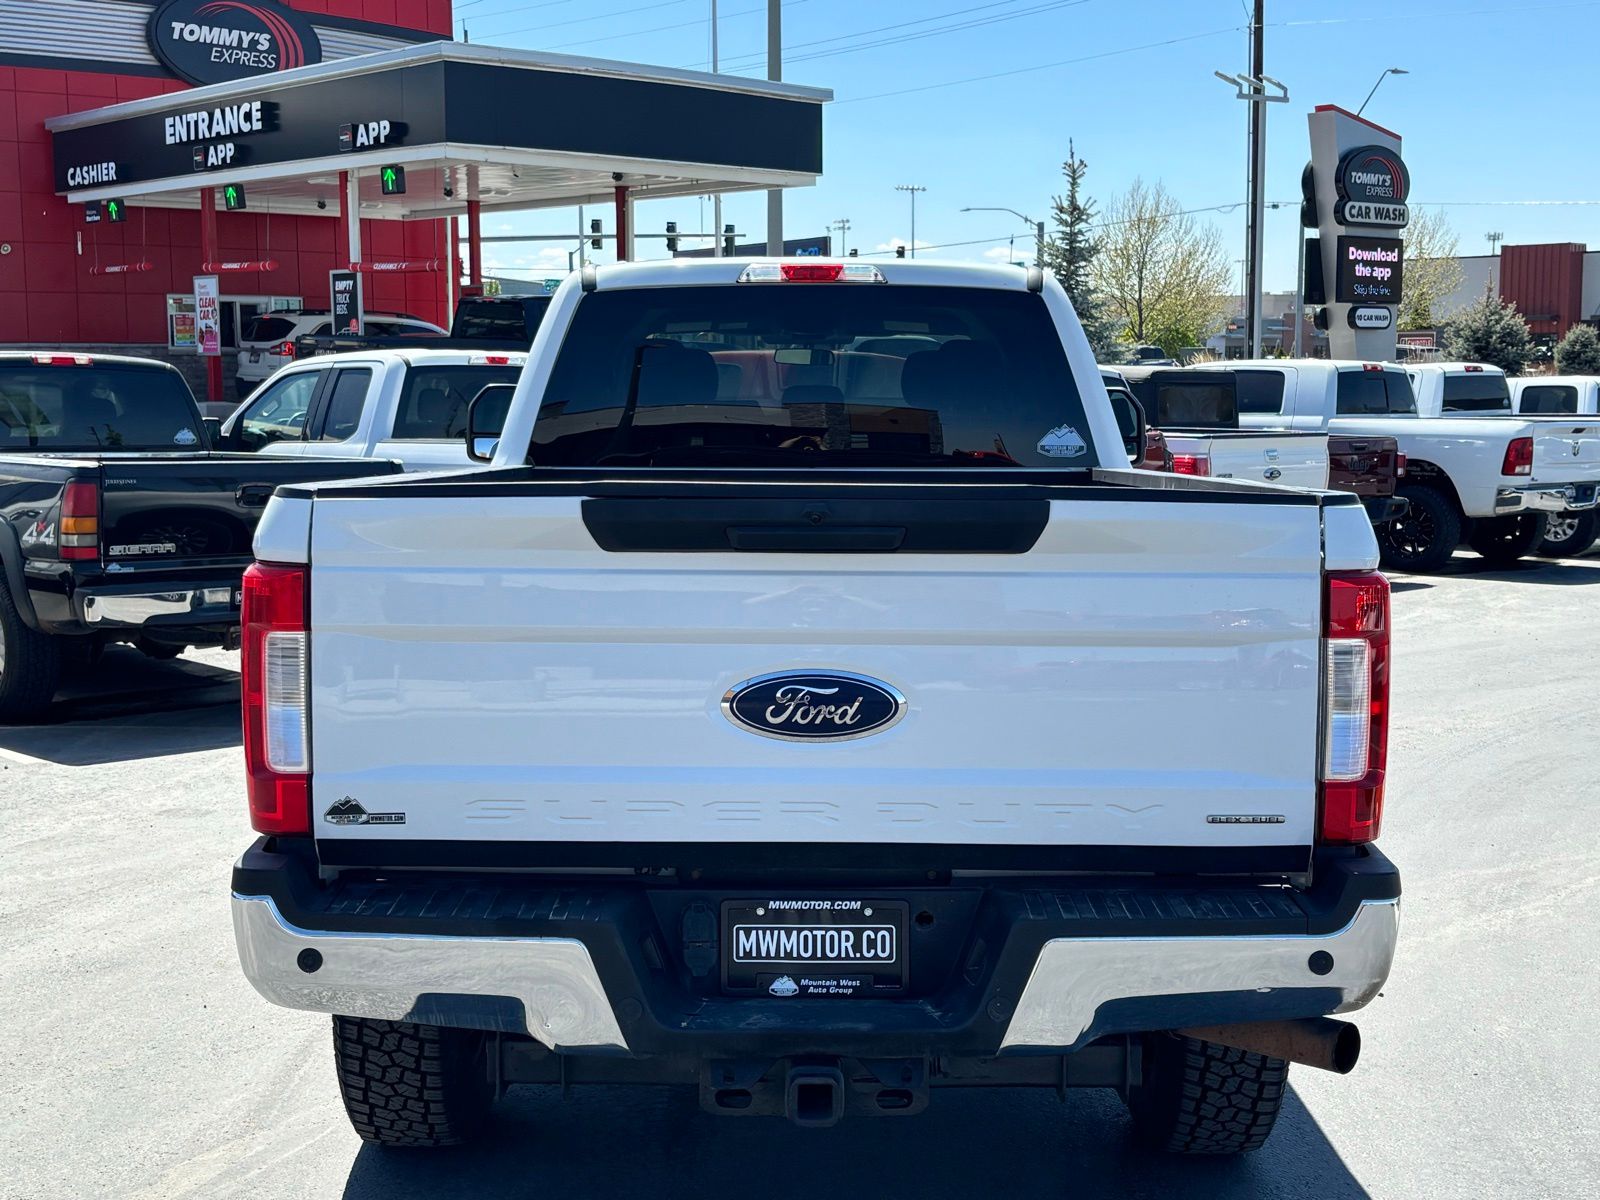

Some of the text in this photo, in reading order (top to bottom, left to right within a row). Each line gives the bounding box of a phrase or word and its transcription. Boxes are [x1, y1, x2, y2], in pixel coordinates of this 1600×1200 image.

[171, 21, 272, 51] TOMMY'S
[211, 47, 277, 69] EXPRESS
[164, 101, 263, 145] ENTRANCE
[356, 120, 390, 147] APP
[207, 143, 235, 167] APP
[67, 162, 117, 187] CASHIER
[1351, 171, 1392, 187] TOMMY'S
[1366, 186, 1393, 198] EXPRESS
[1349, 204, 1406, 222] CAR WASH
[1349, 246, 1398, 262] Download
[1355, 262, 1392, 281] the app
[335, 280, 354, 291] EMPTY
[336, 293, 350, 304] TRUCK
[109, 543, 176, 555] SIERRA
[765, 685, 863, 725] Ford
[465, 799, 1164, 830] SUPER DUTY
[768, 900, 861, 910] MWMOTOR.COM
[738, 930, 891, 958] MWMOTOR.CO
[829, 986, 853, 994] Group
